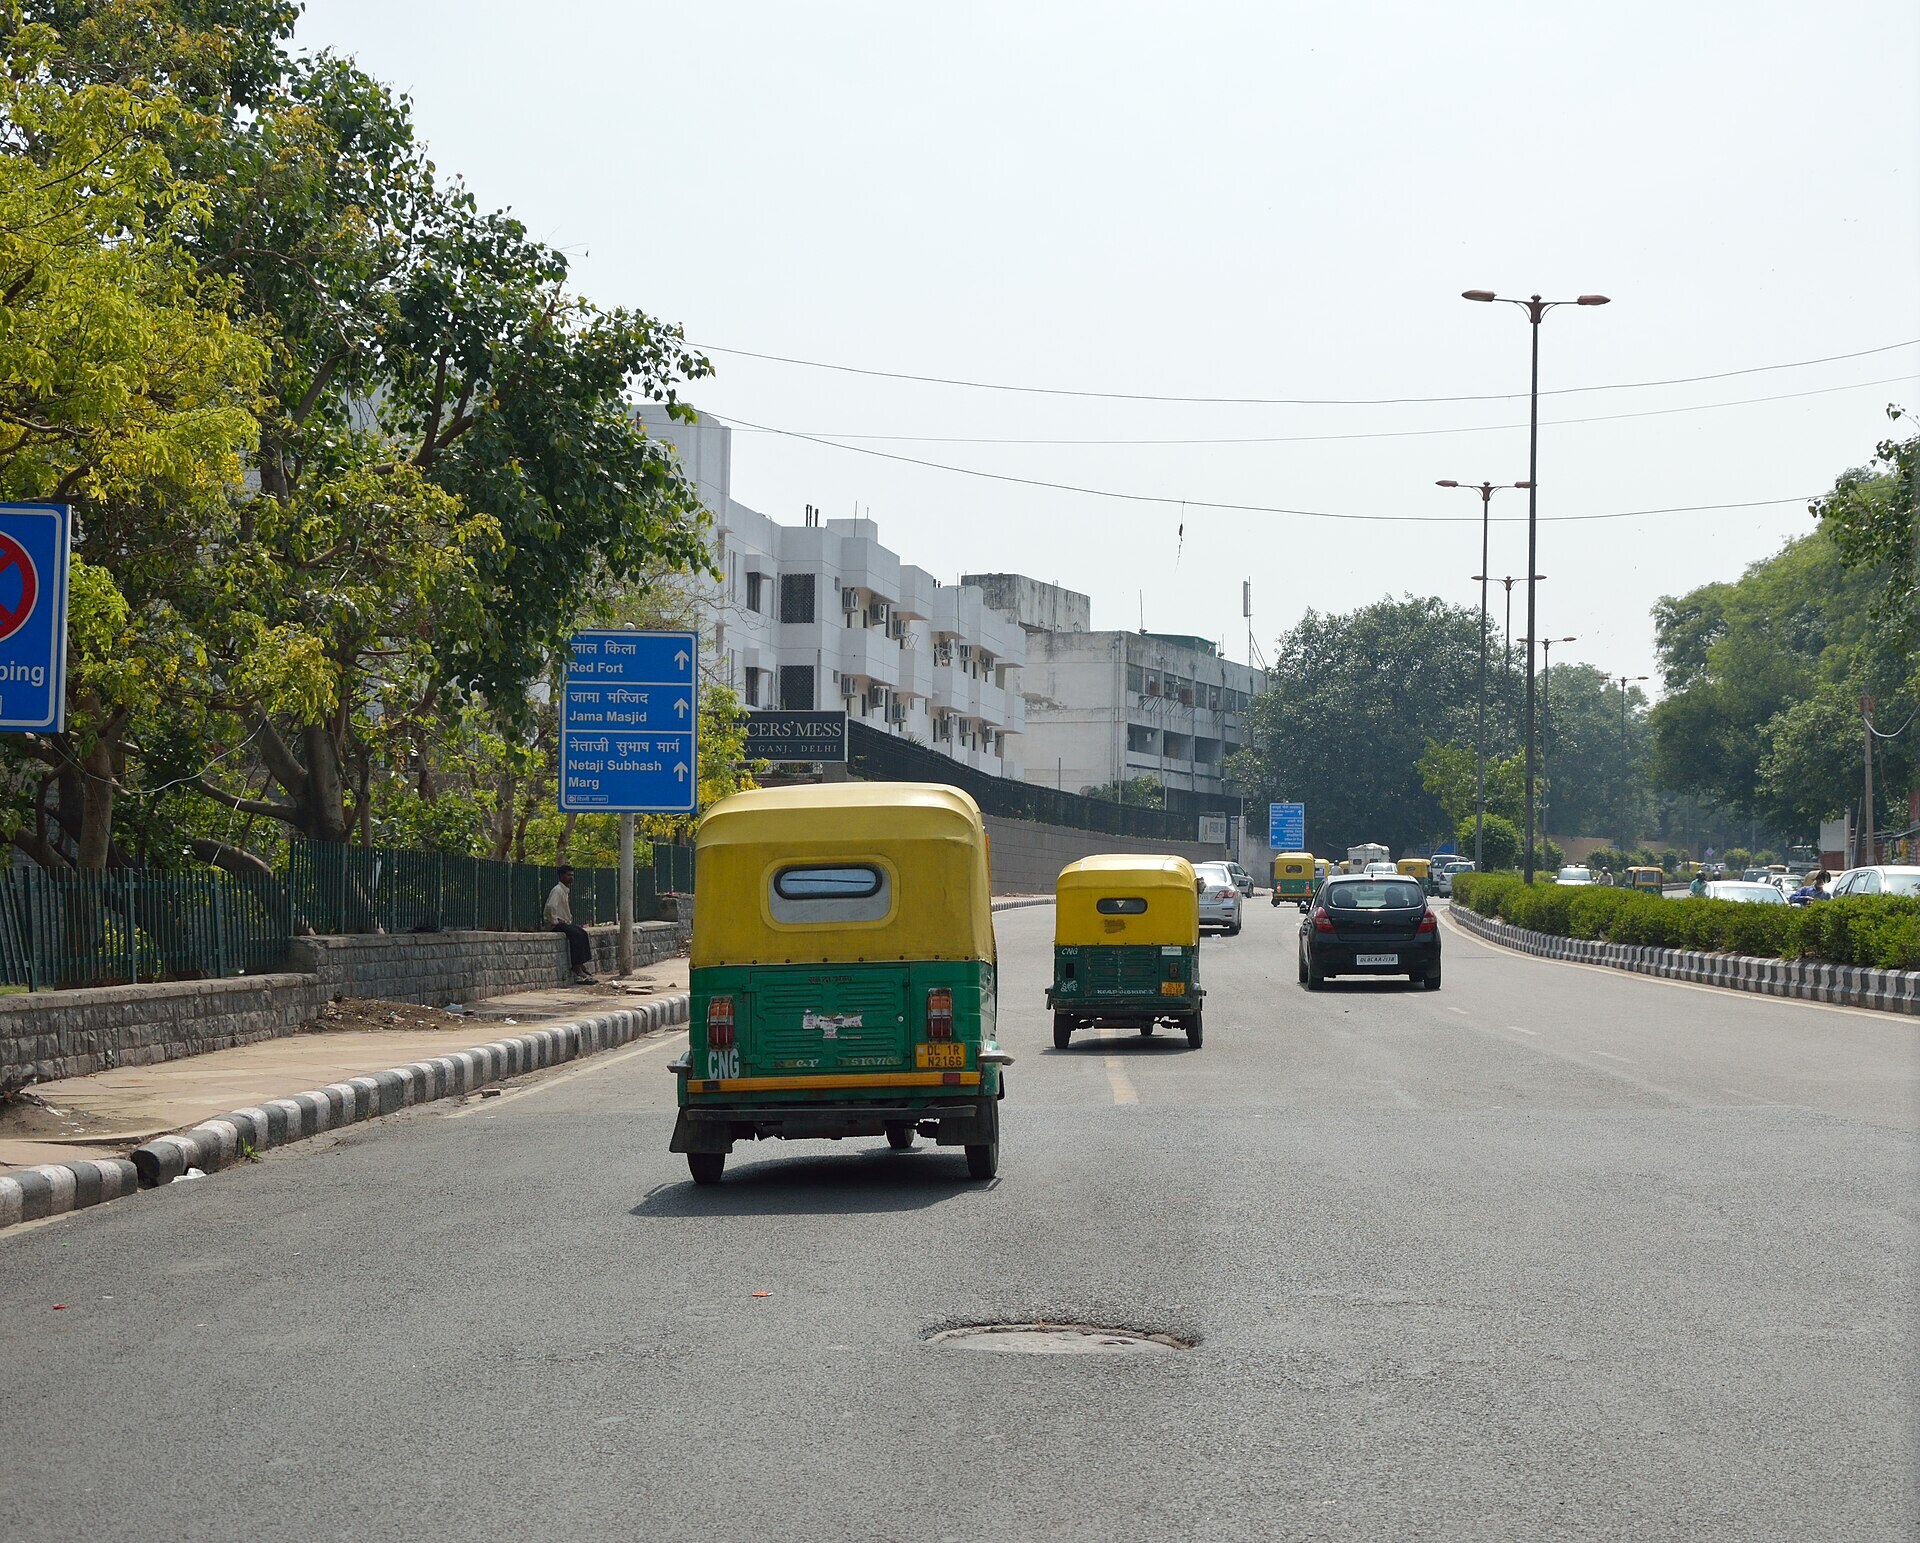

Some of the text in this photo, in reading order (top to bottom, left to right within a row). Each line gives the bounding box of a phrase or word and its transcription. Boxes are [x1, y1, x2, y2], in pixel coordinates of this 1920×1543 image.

[571, 640, 637, 655] लाल किला
[569, 661, 623, 673] Red Fort
[570, 689, 649, 704] जामा मस्जिद
[569, 711, 647, 724] Jama Masjid
[795, 722, 842, 737] MESS
[569, 737, 680, 757] नेताजी सुभाष मार्ग
[568, 760, 662, 773] Netaji Subhash
[568, 777, 600, 790] Marg
[927, 1045, 960, 1056] DL 1R
[708, 1048, 740, 1079] CNG
[928, 1056, 962, 1067] N2166
